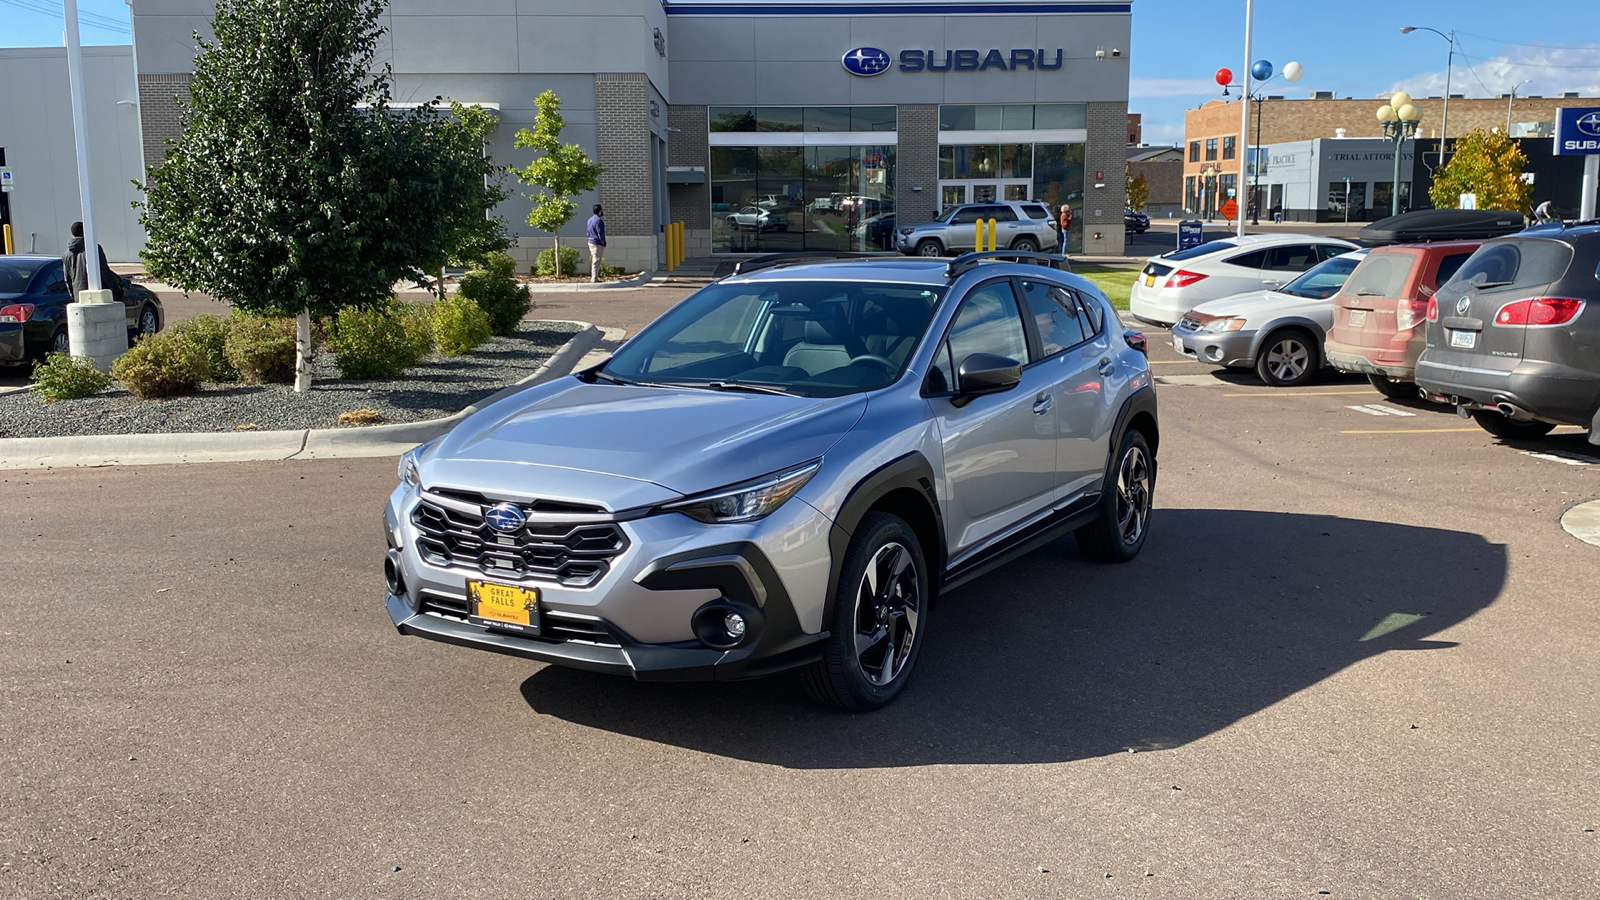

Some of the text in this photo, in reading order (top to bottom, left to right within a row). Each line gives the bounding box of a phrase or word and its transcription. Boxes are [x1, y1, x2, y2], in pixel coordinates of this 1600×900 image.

[899, 48, 1063, 71] SUBARU
[1564, 140, 1600, 150] SUB
[1273, 154, 1296, 165] PRACTICE
[1334, 153, 1361, 161] TRIAL
[490, 588, 514, 598] GREAT
[491, 596, 515, 607] FALLS
[497, 612, 519, 620] SUBARU
